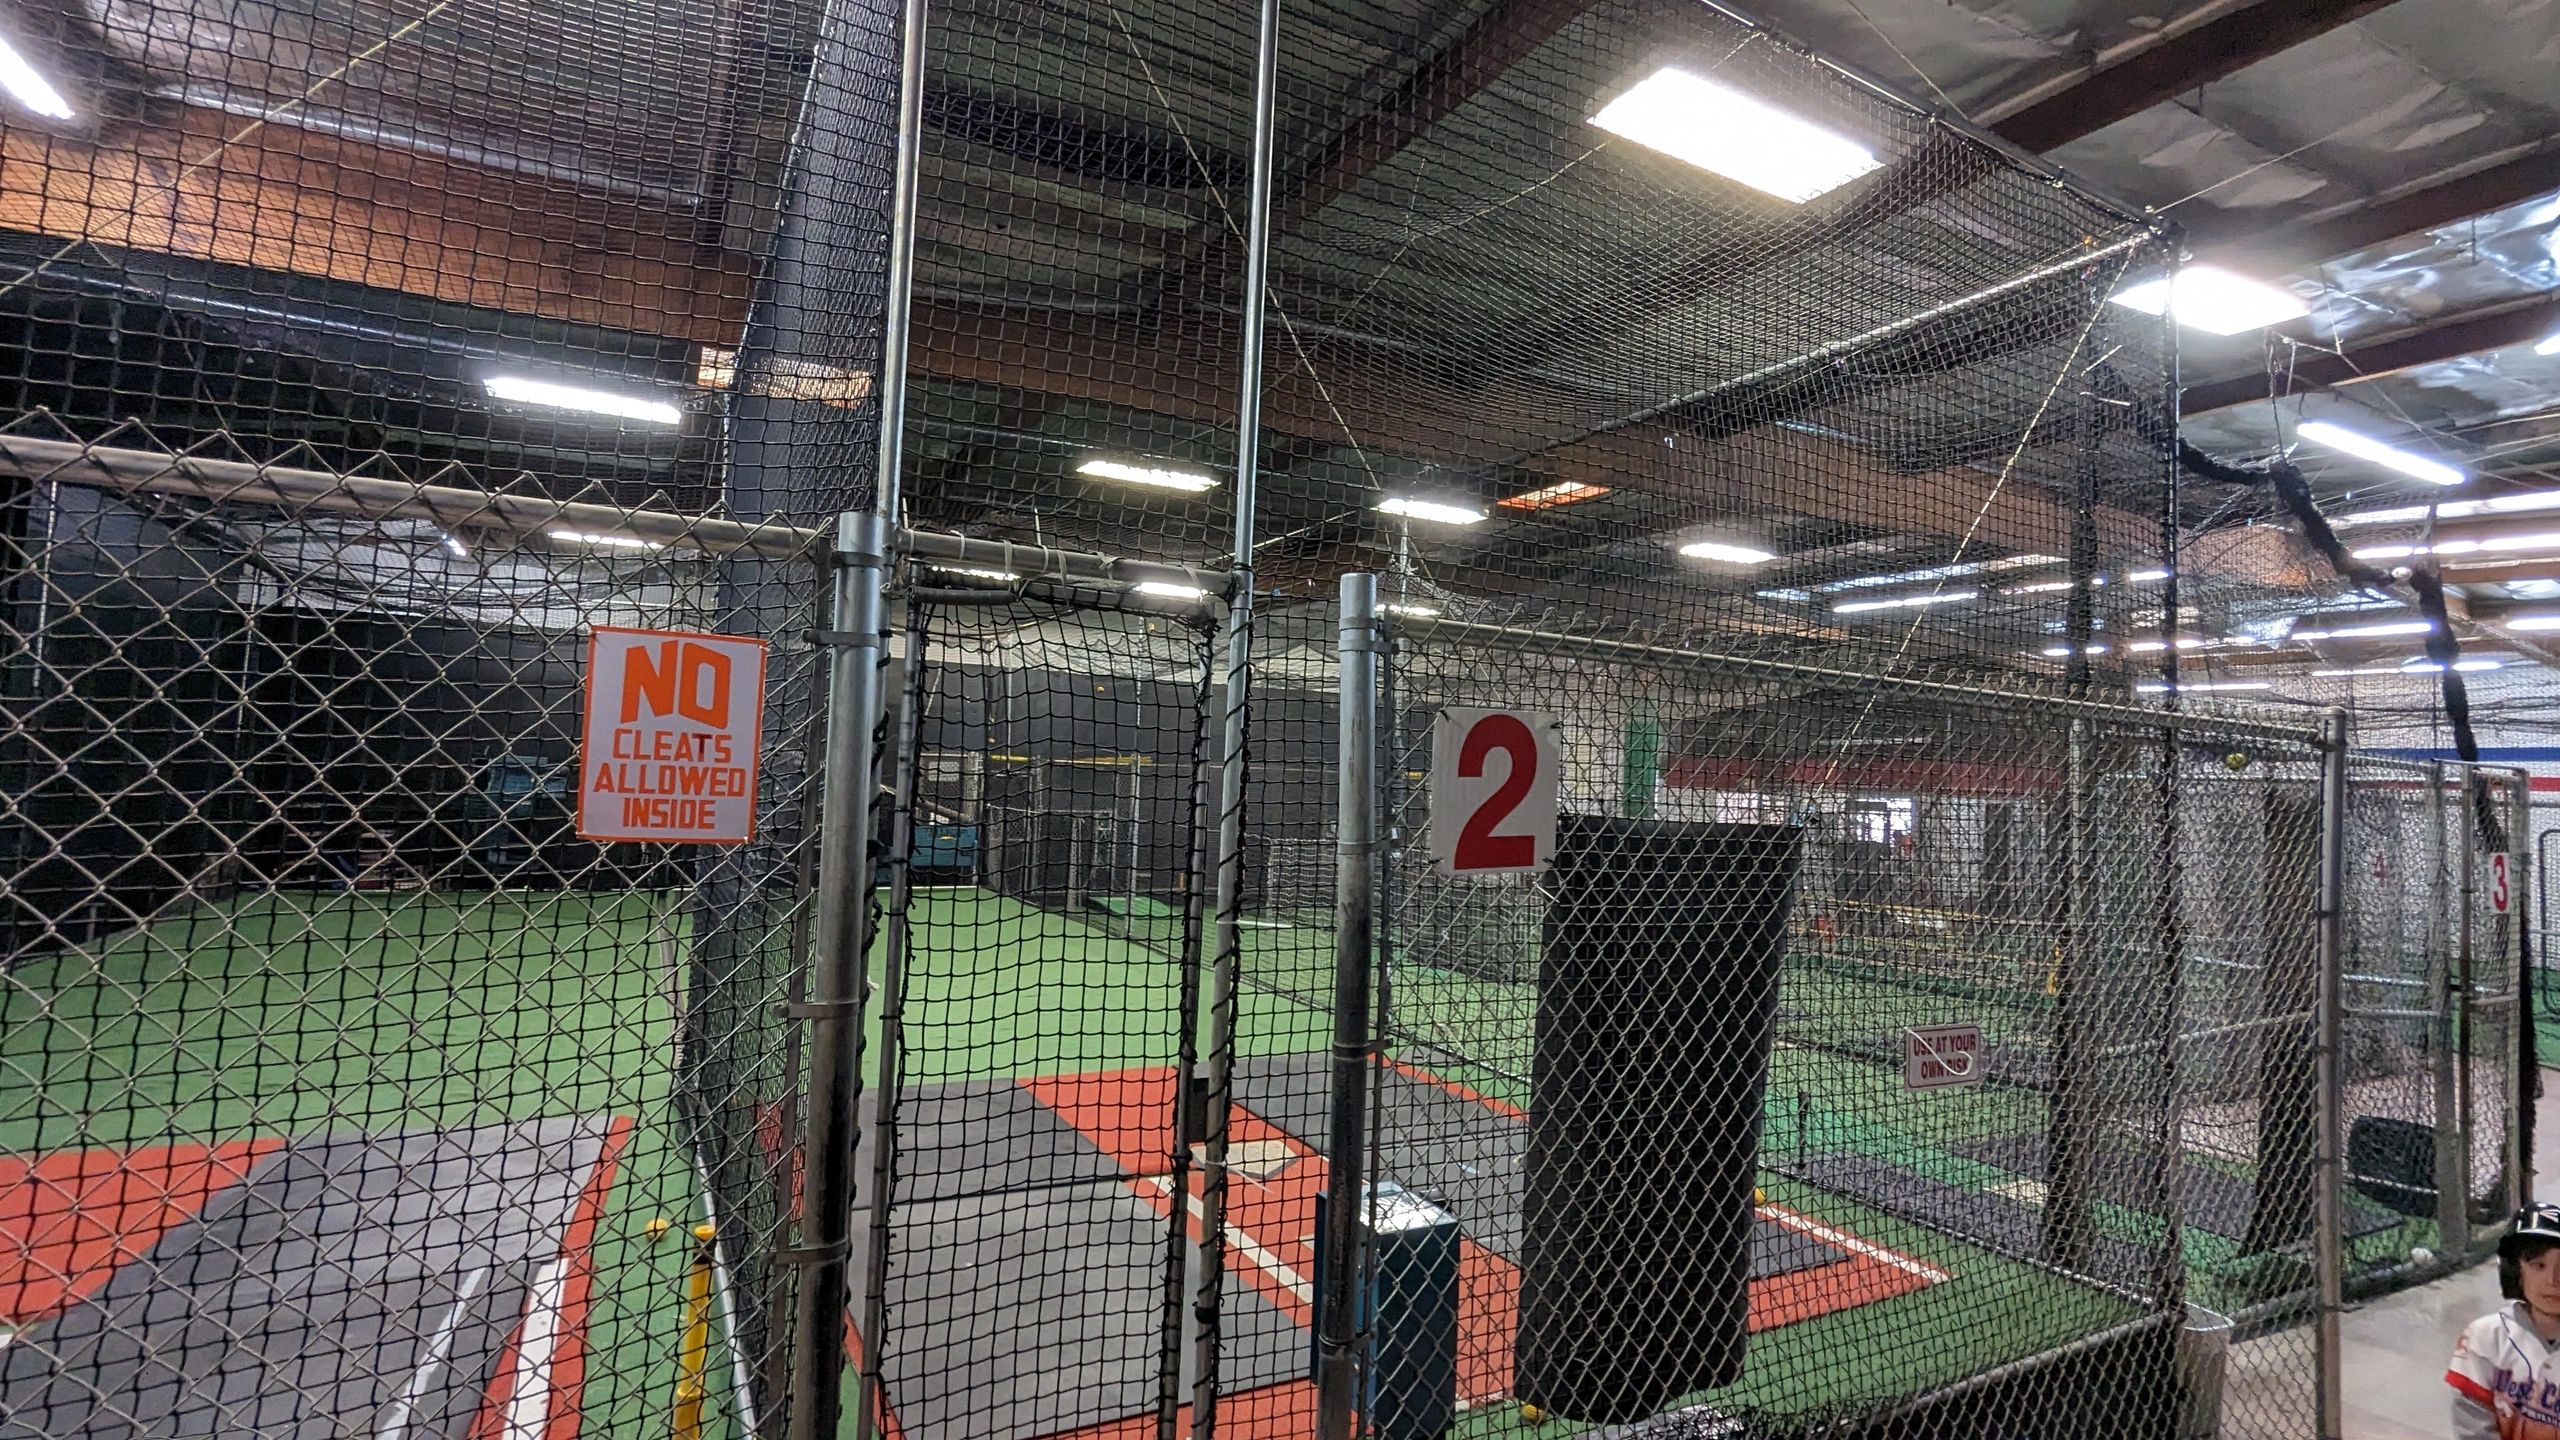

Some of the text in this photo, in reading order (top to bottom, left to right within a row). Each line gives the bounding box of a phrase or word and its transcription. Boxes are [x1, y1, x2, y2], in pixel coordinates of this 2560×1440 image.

[621, 640, 732, 729] NO
[612, 728, 733, 763] CLEATS
[593, 762, 746, 797] ALLOWED
[1454, 714, 1537, 870] 2
[622, 798, 716, 829] INSIDE
[2493, 854, 2508, 912] 3
[1914, 1033, 1976, 1056] USE AT YOUR
[1921, 1060, 1944, 1079] OWN
